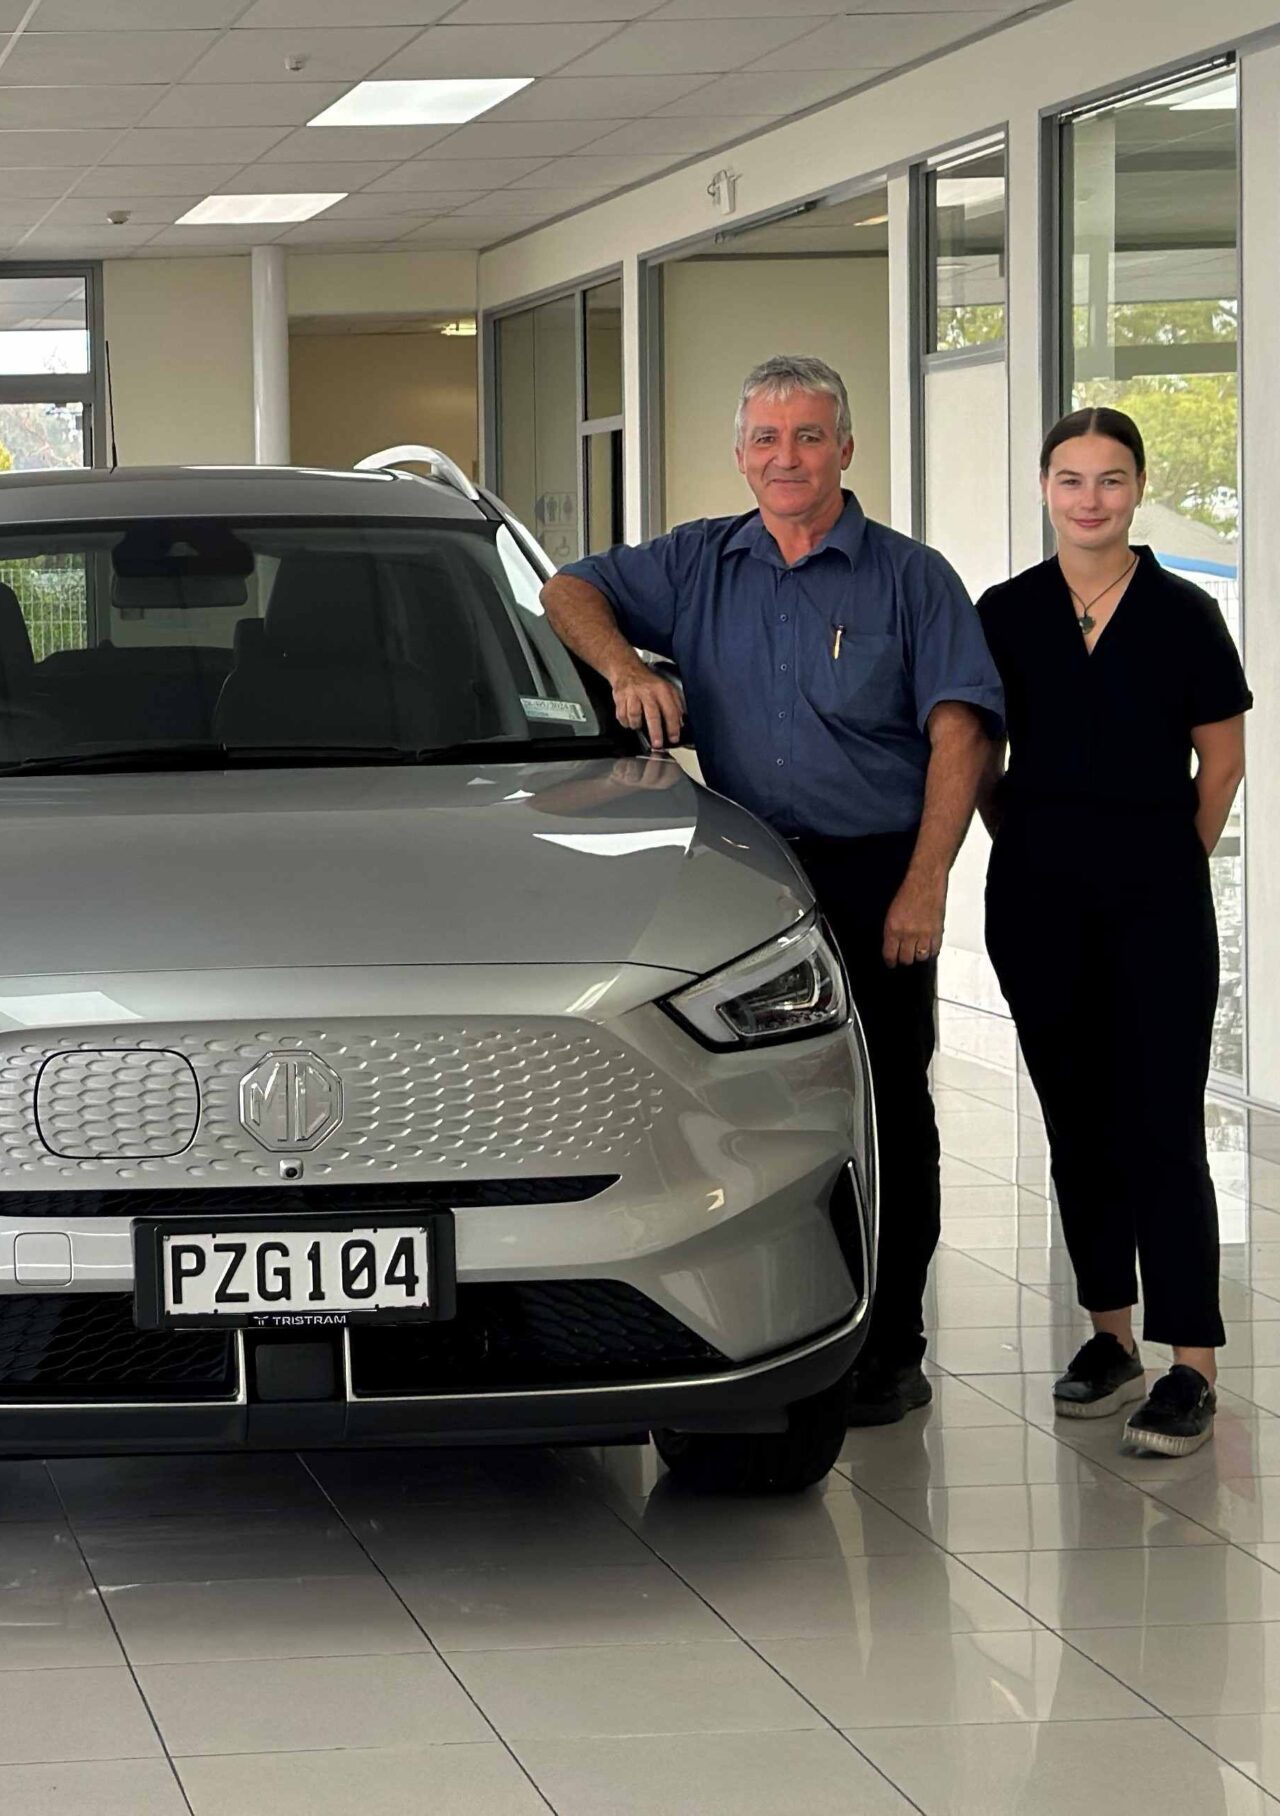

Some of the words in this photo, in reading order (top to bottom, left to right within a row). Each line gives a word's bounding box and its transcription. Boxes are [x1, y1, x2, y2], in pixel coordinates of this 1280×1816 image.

[250, 1061, 332, 1141] MG
[171, 1237, 419, 1304] PZG104
[273, 1315, 347, 1326] TRISTRAM
